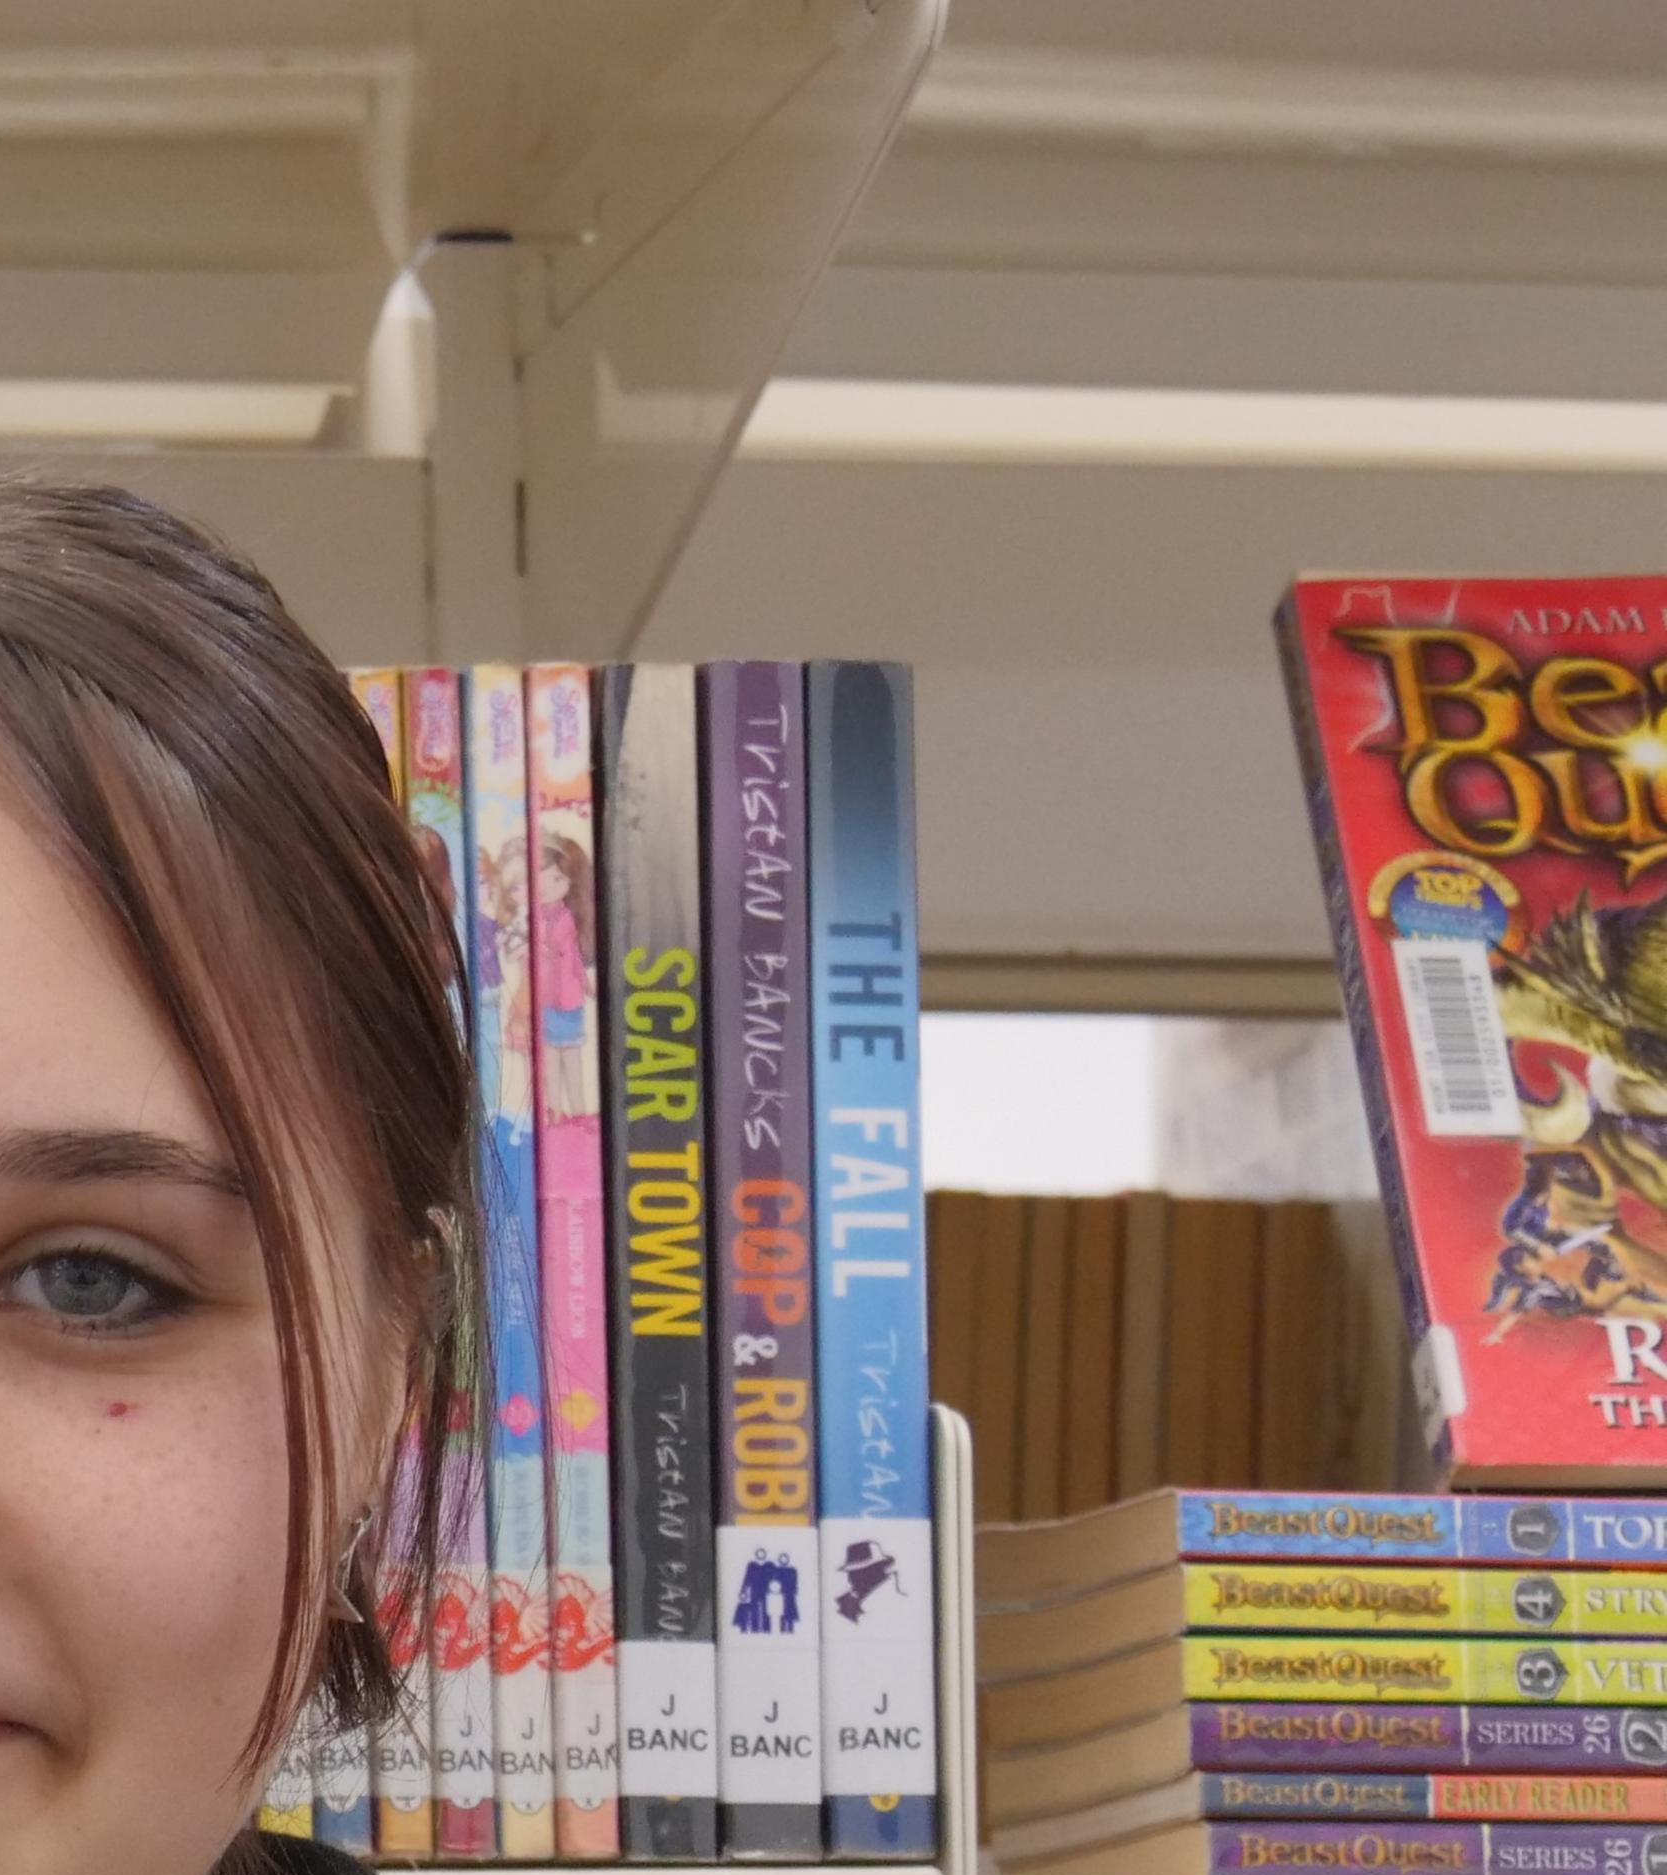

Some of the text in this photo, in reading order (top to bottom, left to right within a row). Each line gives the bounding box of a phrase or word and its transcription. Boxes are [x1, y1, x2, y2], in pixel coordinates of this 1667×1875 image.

[1506, 608, 1646, 635] ADAM
[827, 911, 912, 1298] THE FALL
[623, 945, 703, 1338] SCAR TOWN
[733, 1179, 808, 1327] COP
[732, 1334, 780, 1367] &
[1515, 1523, 1546, 1536] 1
[1516, 1589, 1553, 1619] 4
[1519, 1660, 1557, 1688] 3
[1477, 1714, 1611, 1754] SERIES 26
[1441, 1780, 1629, 1812] EARLY READER
[1498, 1847, 1597, 1870] SERIES
